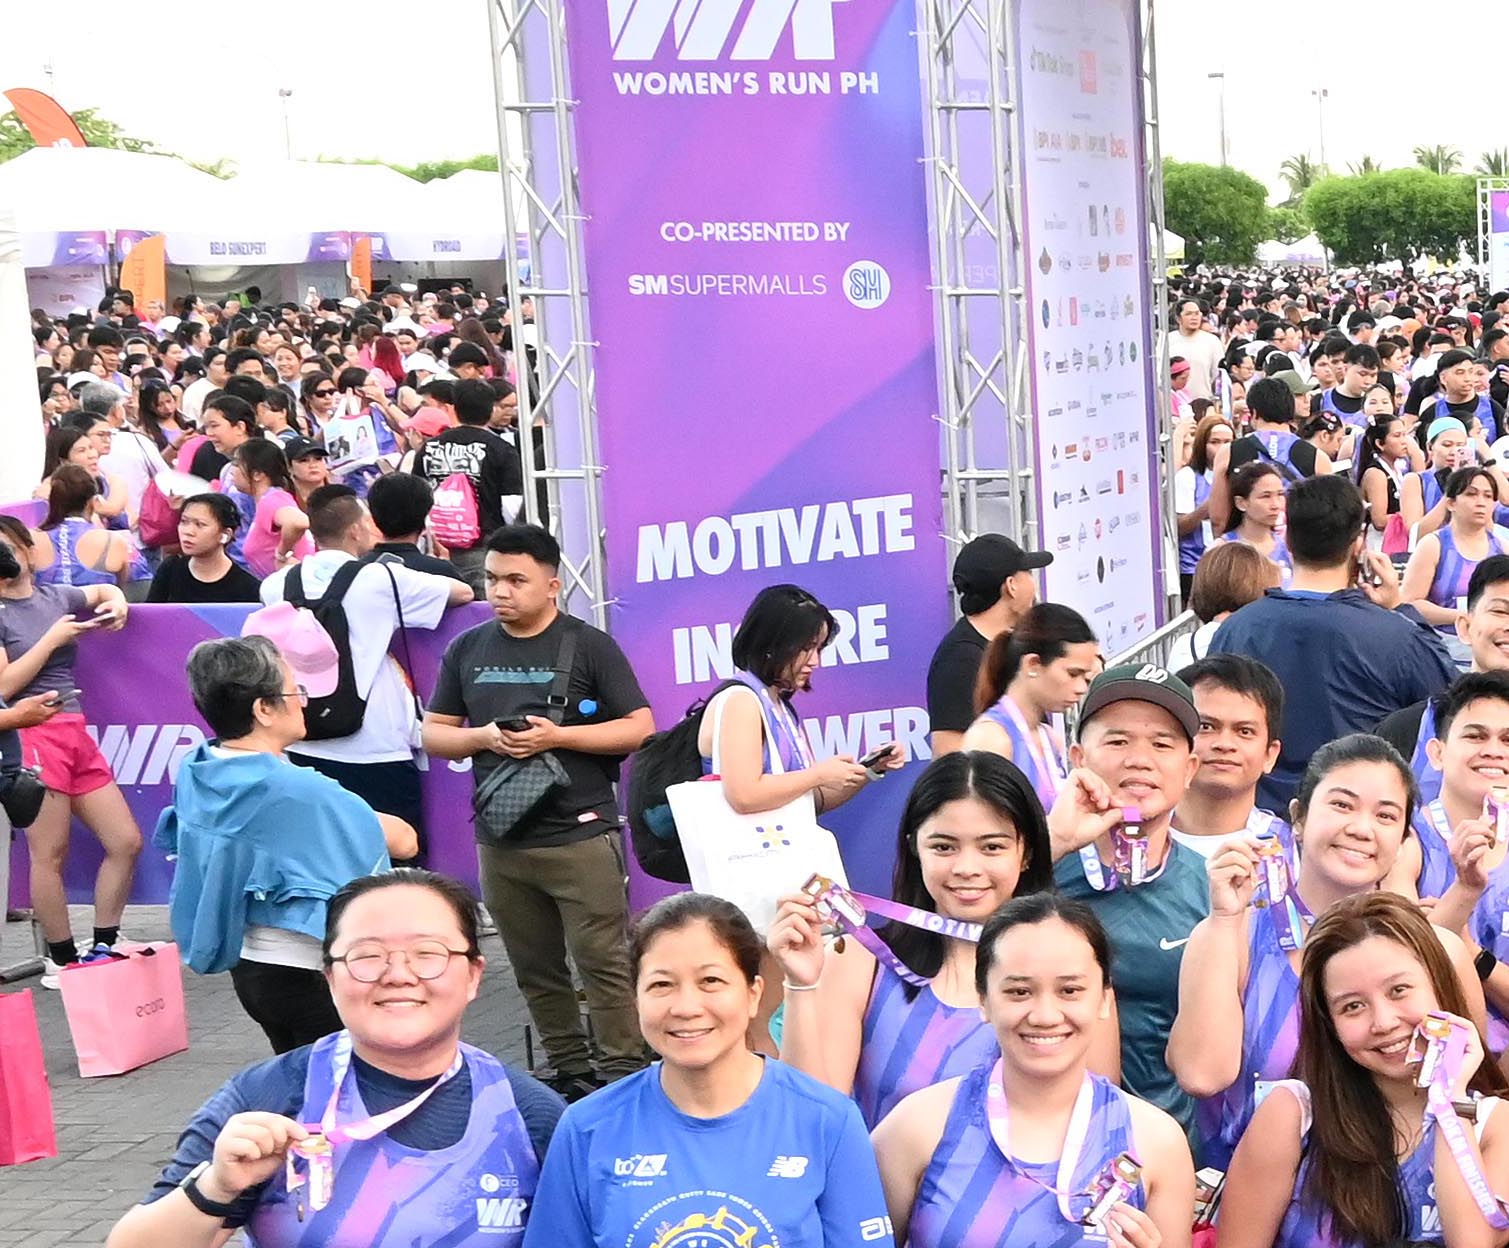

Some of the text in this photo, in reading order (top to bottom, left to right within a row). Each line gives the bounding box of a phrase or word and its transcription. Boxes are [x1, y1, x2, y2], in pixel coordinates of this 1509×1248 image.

[613, 71, 879, 95] WOMEN'S RUN PH
[660, 221, 850, 242] CO-PRESENTED BY
[636, 493, 915, 584] MOTIVATE
[672, 603, 890, 685] INRE
[907, 909, 984, 942] MOTIV
[476, 1198, 527, 1227] WR
